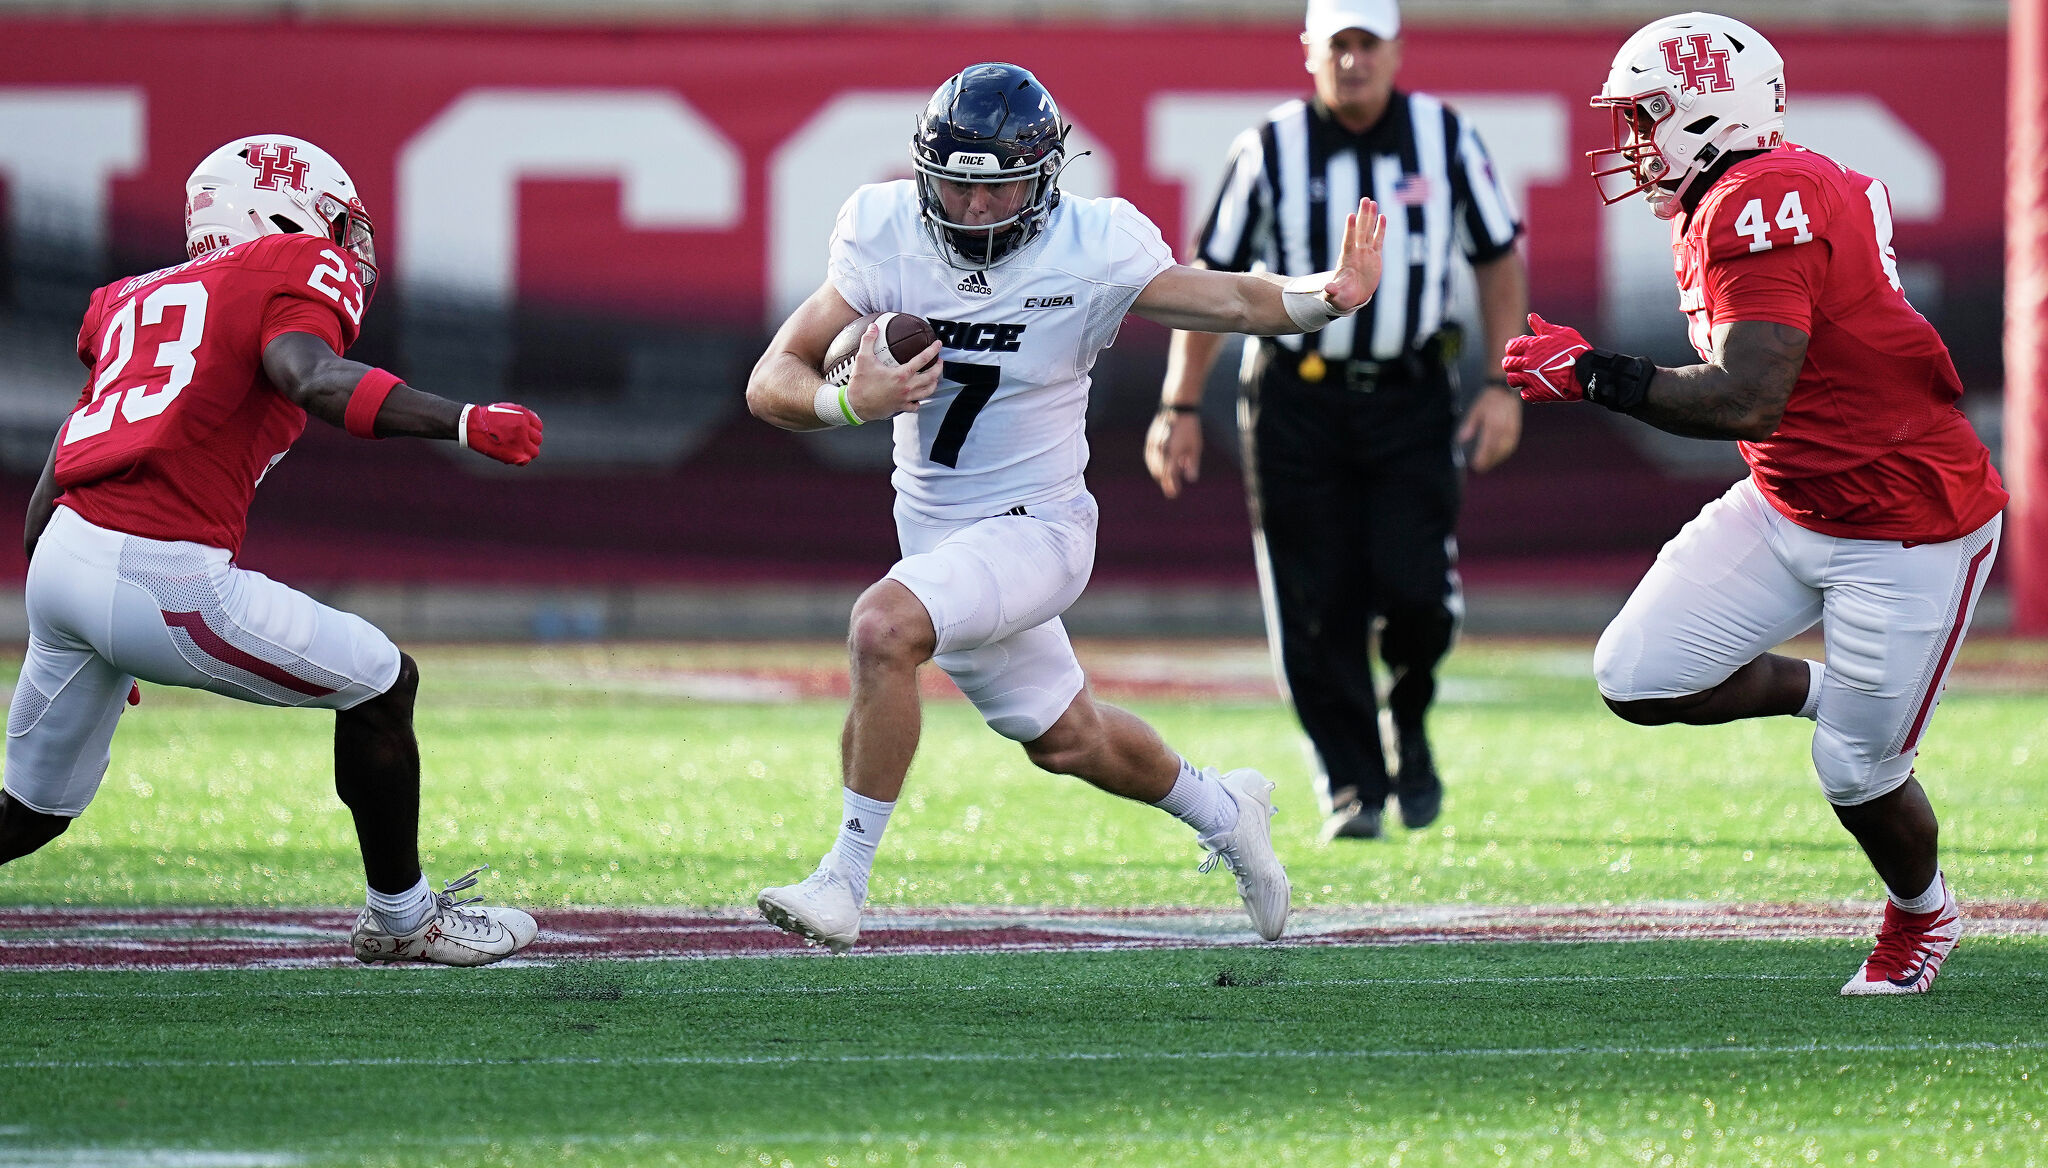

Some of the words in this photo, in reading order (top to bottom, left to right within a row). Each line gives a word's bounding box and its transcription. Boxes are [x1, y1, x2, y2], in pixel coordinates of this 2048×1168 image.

[1658, 33, 1735, 96] UH
[245, 142, 310, 194] UH
[958, 155, 986, 166] RICE
[1734, 190, 1813, 253] 44
[306, 248, 364, 326] 23
[957, 282, 993, 296] adidas
[62, 279, 209, 447] 23
[926, 316, 1027, 353] RICE
[929, 360, 1001, 470] 7
